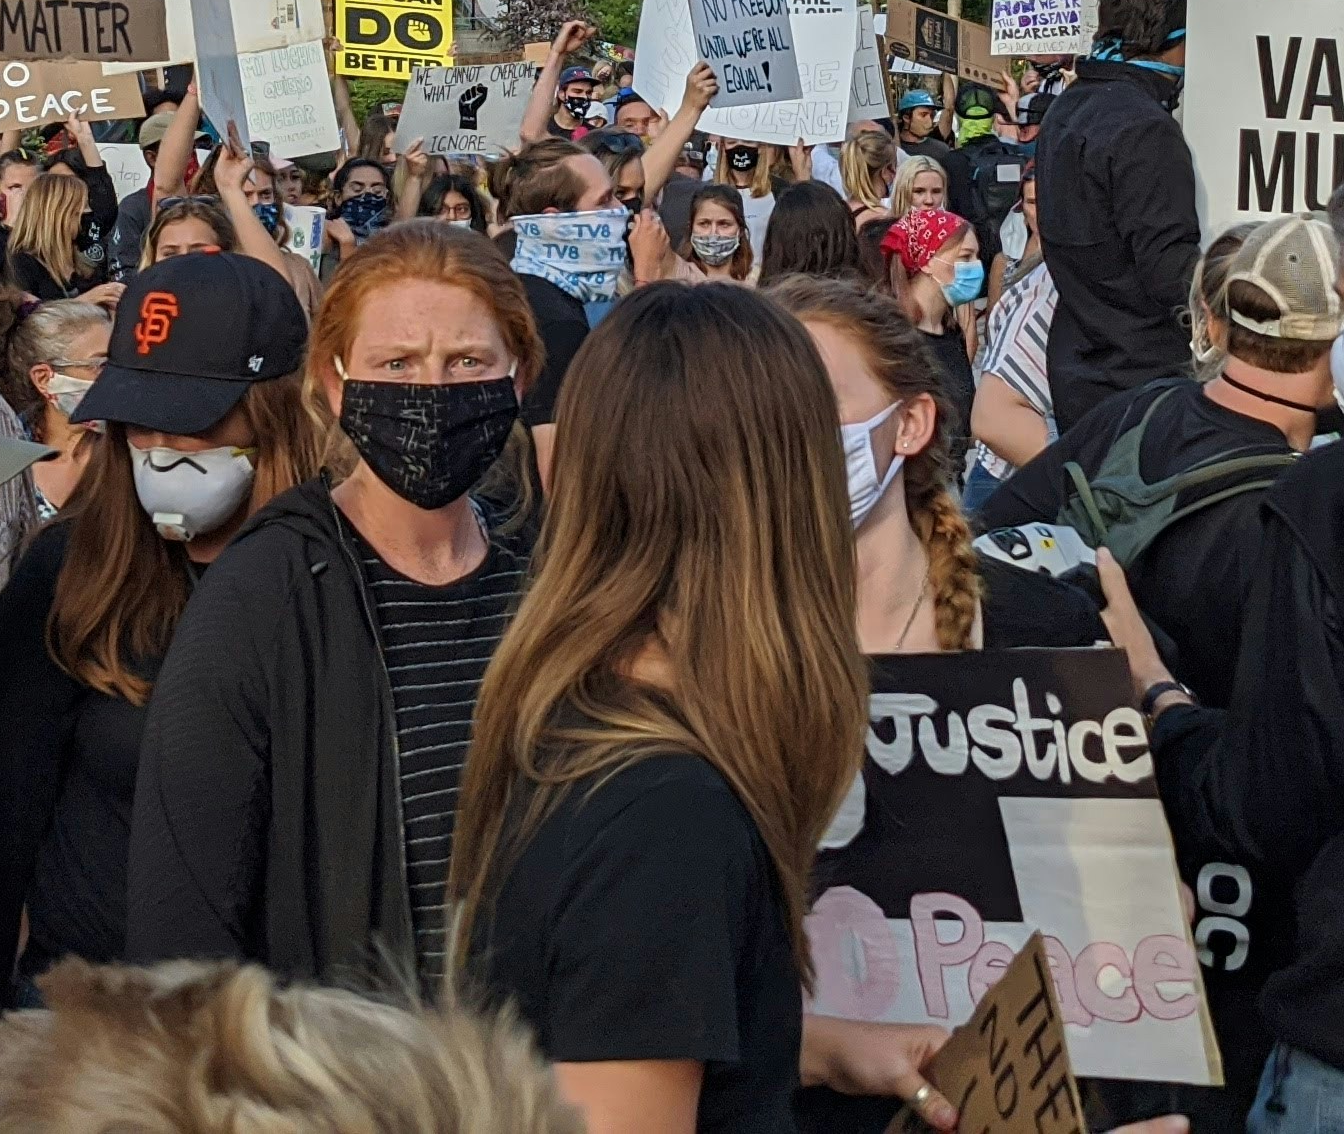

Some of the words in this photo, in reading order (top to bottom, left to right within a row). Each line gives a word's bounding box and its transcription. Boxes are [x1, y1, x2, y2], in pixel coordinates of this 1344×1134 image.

[345, 7, 444, 50] DO
[698, 33, 733, 59] UNTIL
[769, 27, 790, 51] ALL
[416, 68, 432, 86] WE
[445, 66, 485, 85] CANNOT
[423, 86, 454, 103] WHAT
[503, 79, 517, 98] WE
[431, 135, 487, 153] IGNORE
[112, 161, 141, 187] top
[572, 224, 611, 238] TV8
[542, 244, 580, 260] TV8
[135, 291, 180, 354] SF
[865, 676, 1154, 784] Justice
